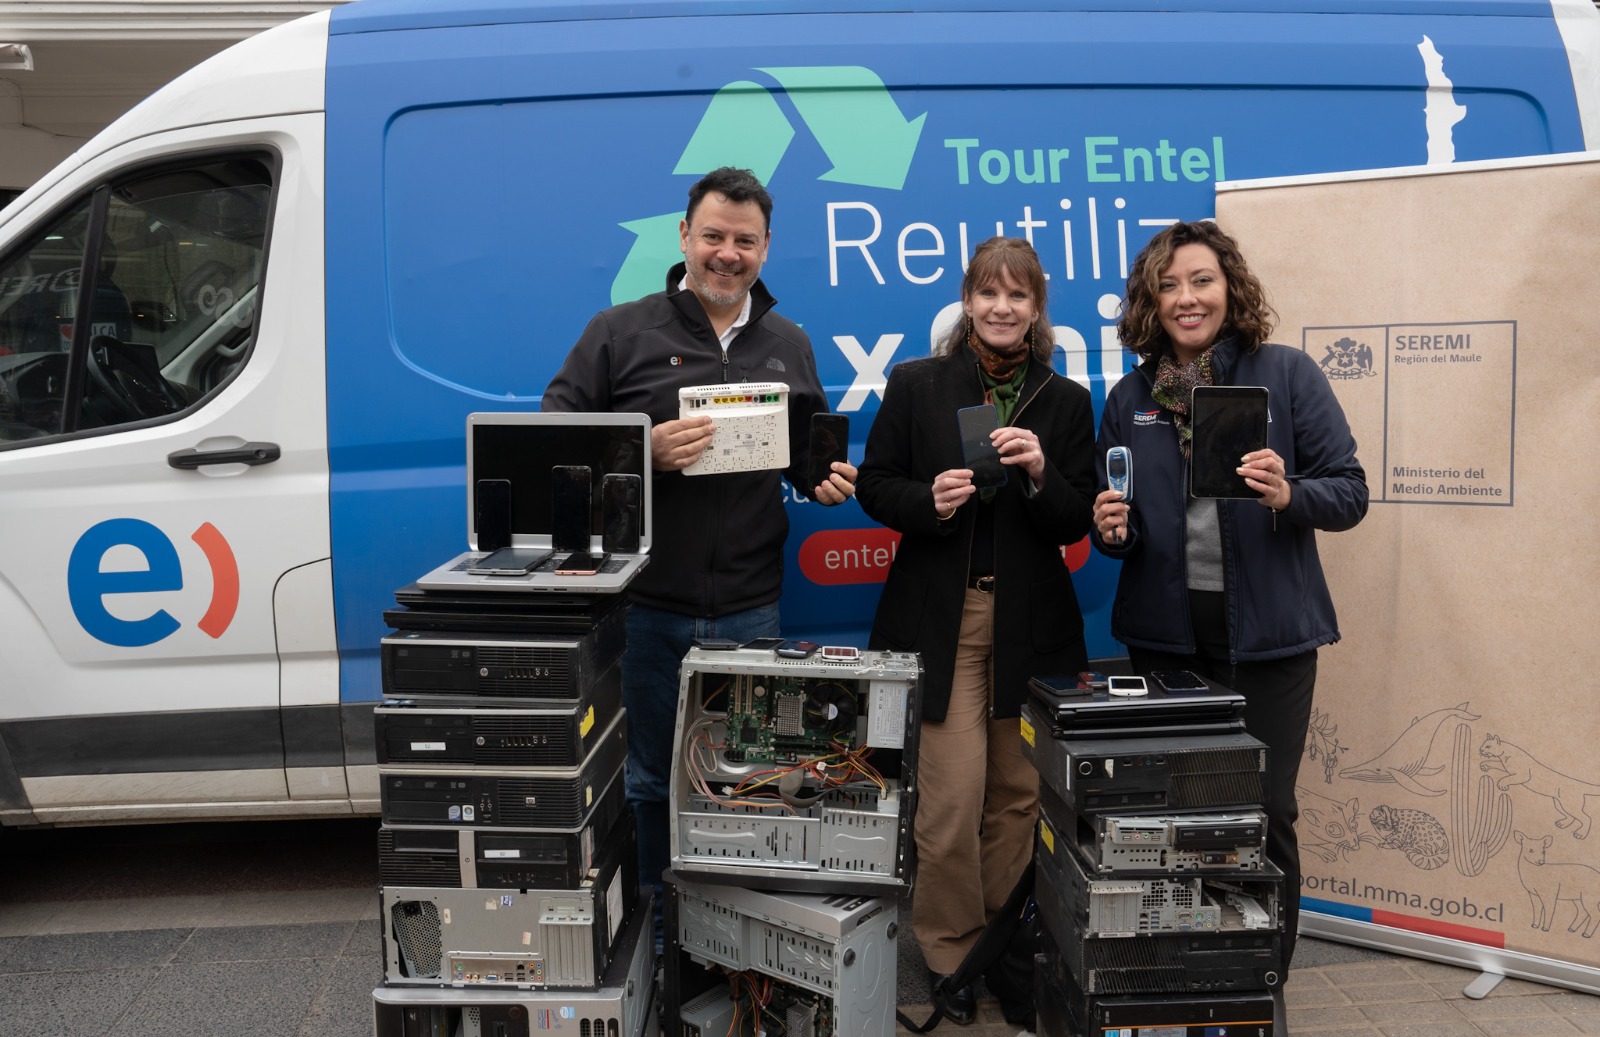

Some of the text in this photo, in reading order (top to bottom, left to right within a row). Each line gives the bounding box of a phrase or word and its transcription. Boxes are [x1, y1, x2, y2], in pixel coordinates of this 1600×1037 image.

[944, 136, 1226, 184] Tour Entel
[827, 196, 1216, 287] Reutili
[1395, 334, 1471, 350] SEREMI
[1431, 354, 1447, 363] del
[1450, 354, 1482, 362] Maule
[1393, 466, 1485, 479] Ministerio del
[1392, 483, 1502, 496] Medio Ambiente
